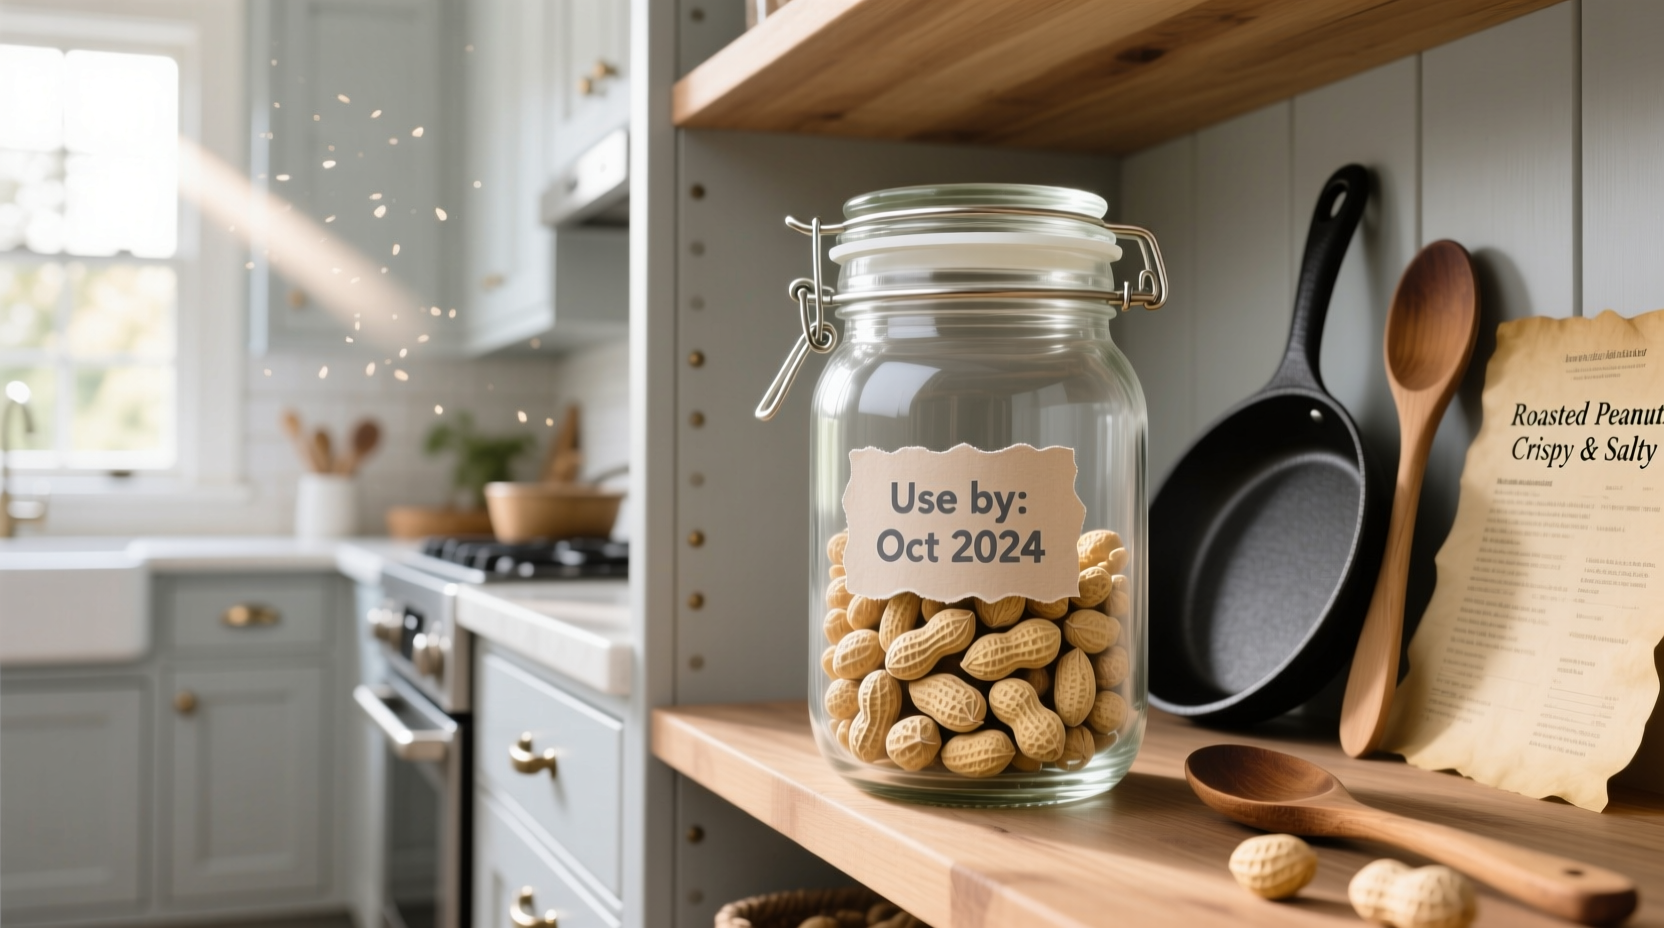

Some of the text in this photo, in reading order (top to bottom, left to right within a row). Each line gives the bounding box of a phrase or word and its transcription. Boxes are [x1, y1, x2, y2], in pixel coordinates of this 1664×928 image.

[1510, 401, 1664, 426] Roasted Peanut
[1511, 435, 1658, 469] Crispy & Salty
[891, 480, 1027, 523] Use by:
[876, 528, 1046, 564] Oct 2024
